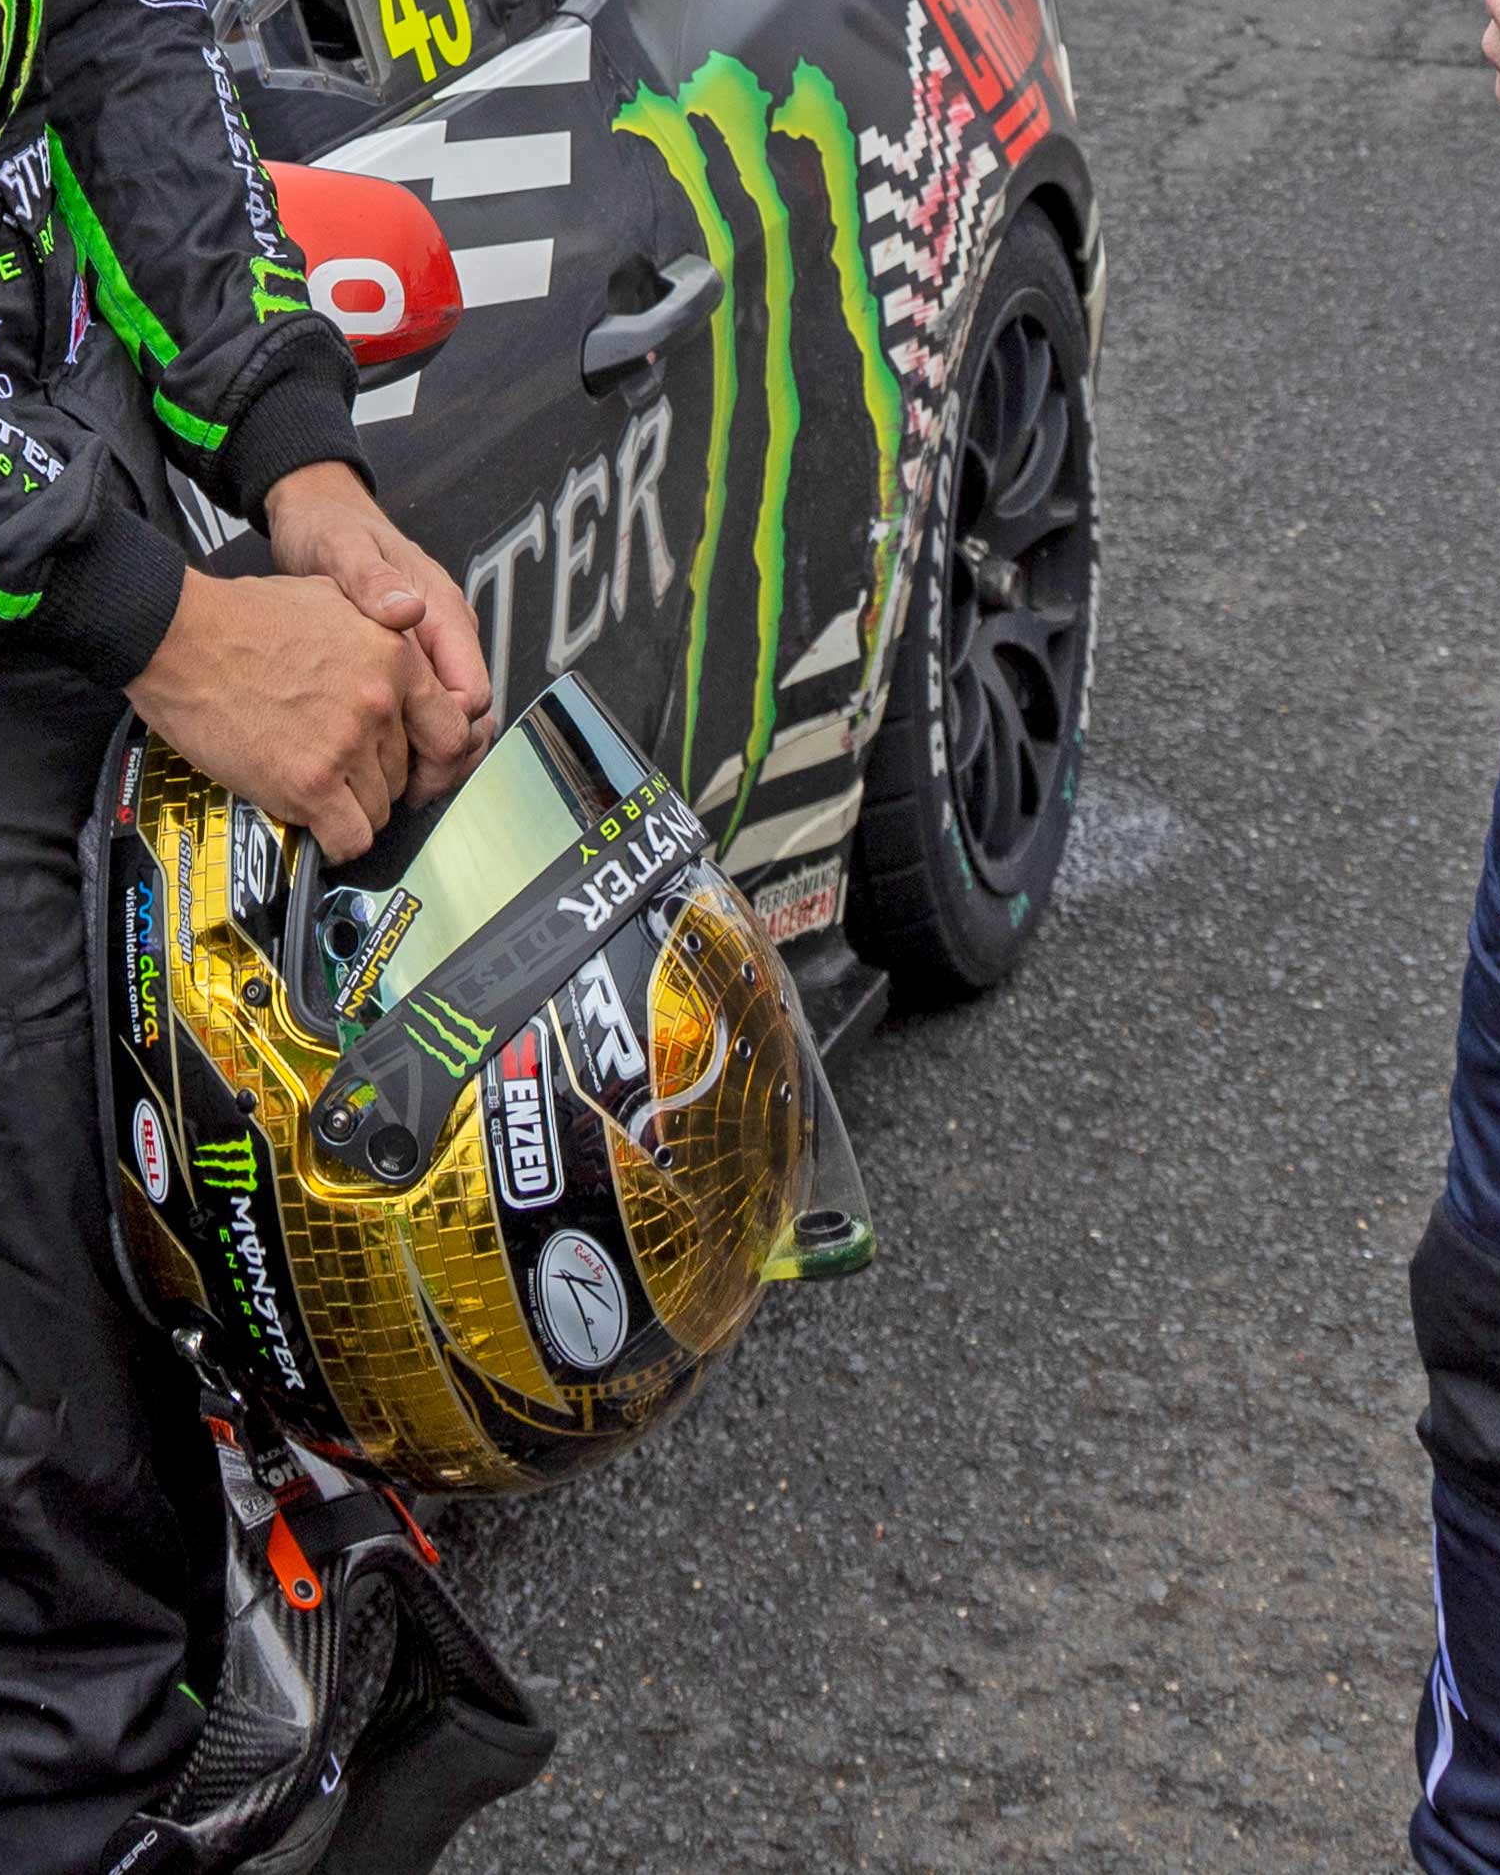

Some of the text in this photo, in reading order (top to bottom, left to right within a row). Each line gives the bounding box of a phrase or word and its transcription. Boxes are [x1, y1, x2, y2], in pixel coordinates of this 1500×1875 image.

[120, 746, 141, 807] Forklifts
[124, 886, 142, 1044] visitmildura.com.au
[177, 886, 194, 963] Design
[333, 890, 407, 1013] electrical
[583, 1042, 603, 1094] RACING
[139, 1118, 159, 1189] BELL
[502, 1077, 550, 1194] ENZED
[218, 1227, 270, 1360] ENERGY
[229, 1194, 307, 1390] MONSTER
